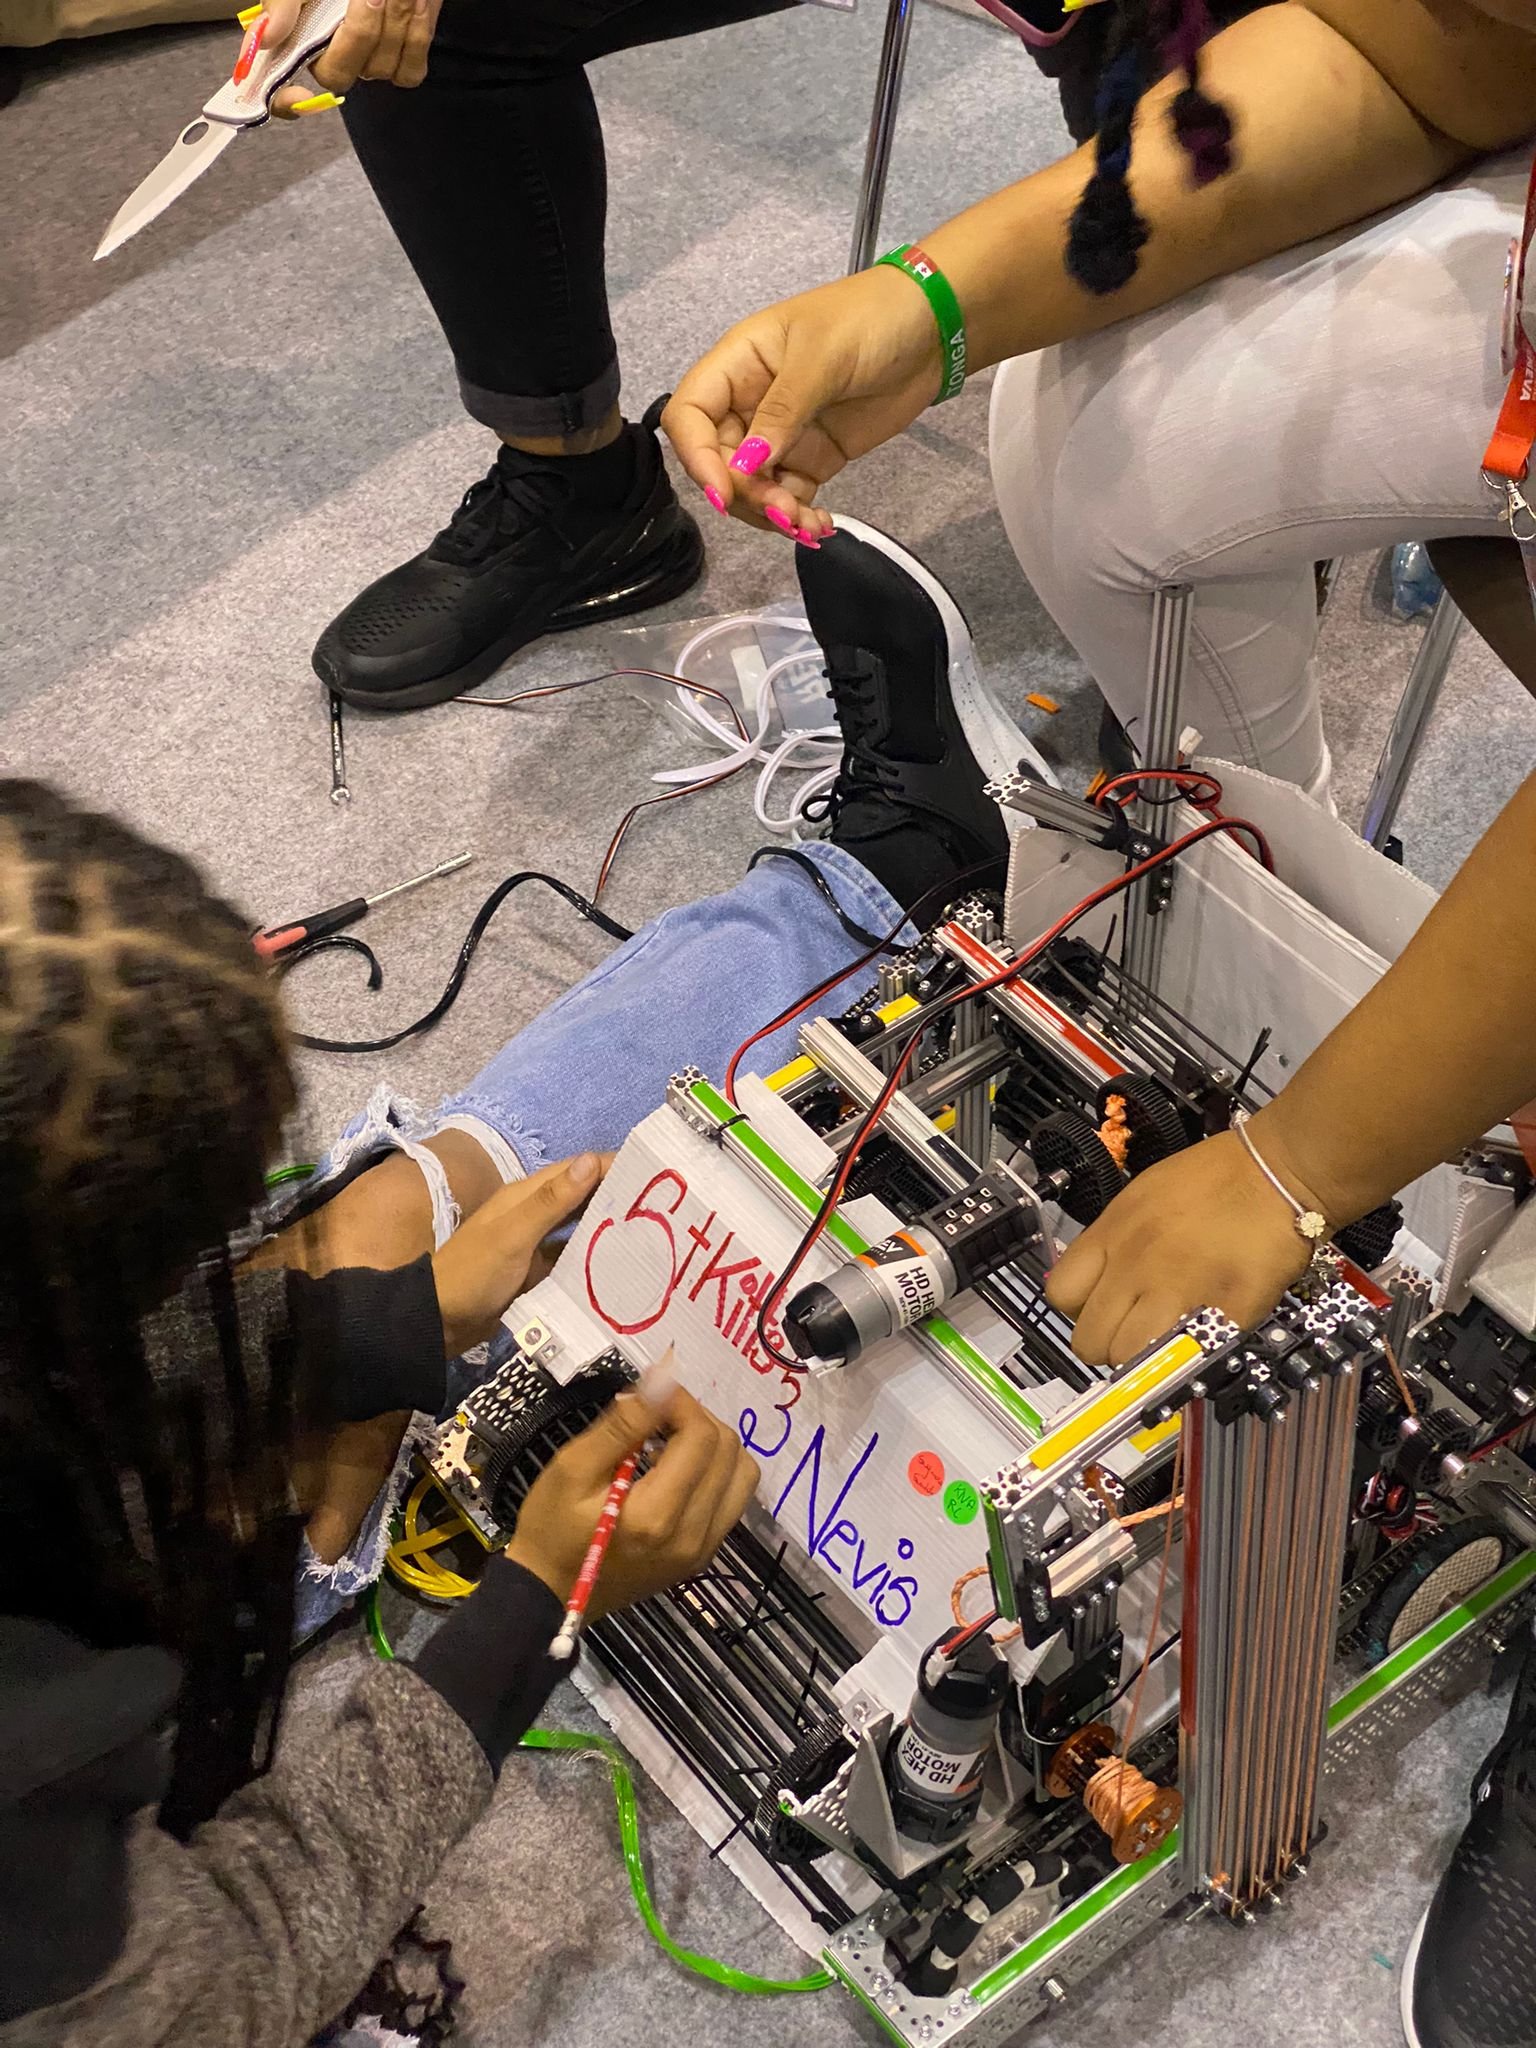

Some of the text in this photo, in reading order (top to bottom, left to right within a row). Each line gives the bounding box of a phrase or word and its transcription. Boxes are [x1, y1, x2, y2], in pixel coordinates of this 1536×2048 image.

[946, 328, 965, 396] TONGA
[910, 1266, 936, 1315] HD HE
[773, 1425, 917, 1626] Nevis
[906, 1737, 962, 1773] MOTOR
[928, 1771, 955, 1785] HD
